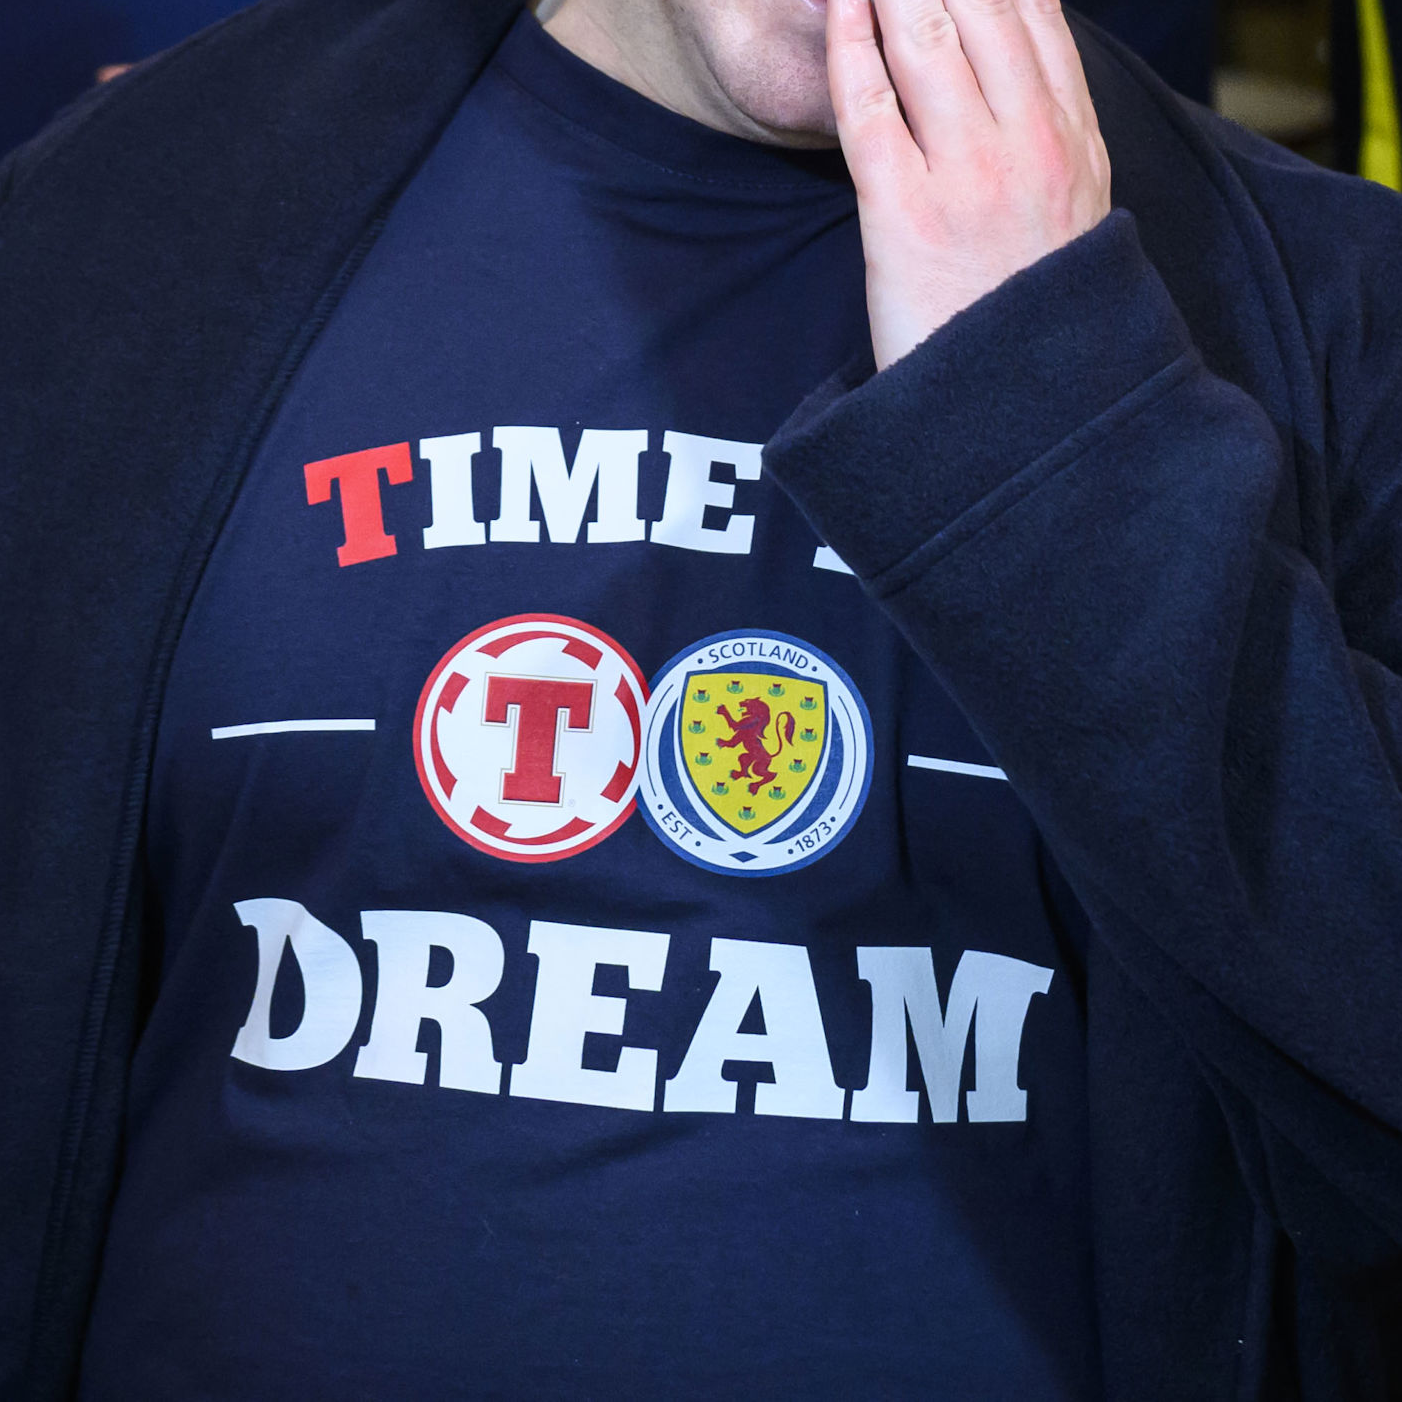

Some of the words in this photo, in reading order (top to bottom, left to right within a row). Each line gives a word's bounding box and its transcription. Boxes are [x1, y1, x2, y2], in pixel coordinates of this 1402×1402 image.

[304, 425, 764, 567] TIME
[708, 642, 809, 670] SCOTLAND
[481, 672, 598, 808] T
[662, 811, 693, 841] EST
[794, 820, 832, 853] 1873
[231, 897, 1054, 1123] DREAM
